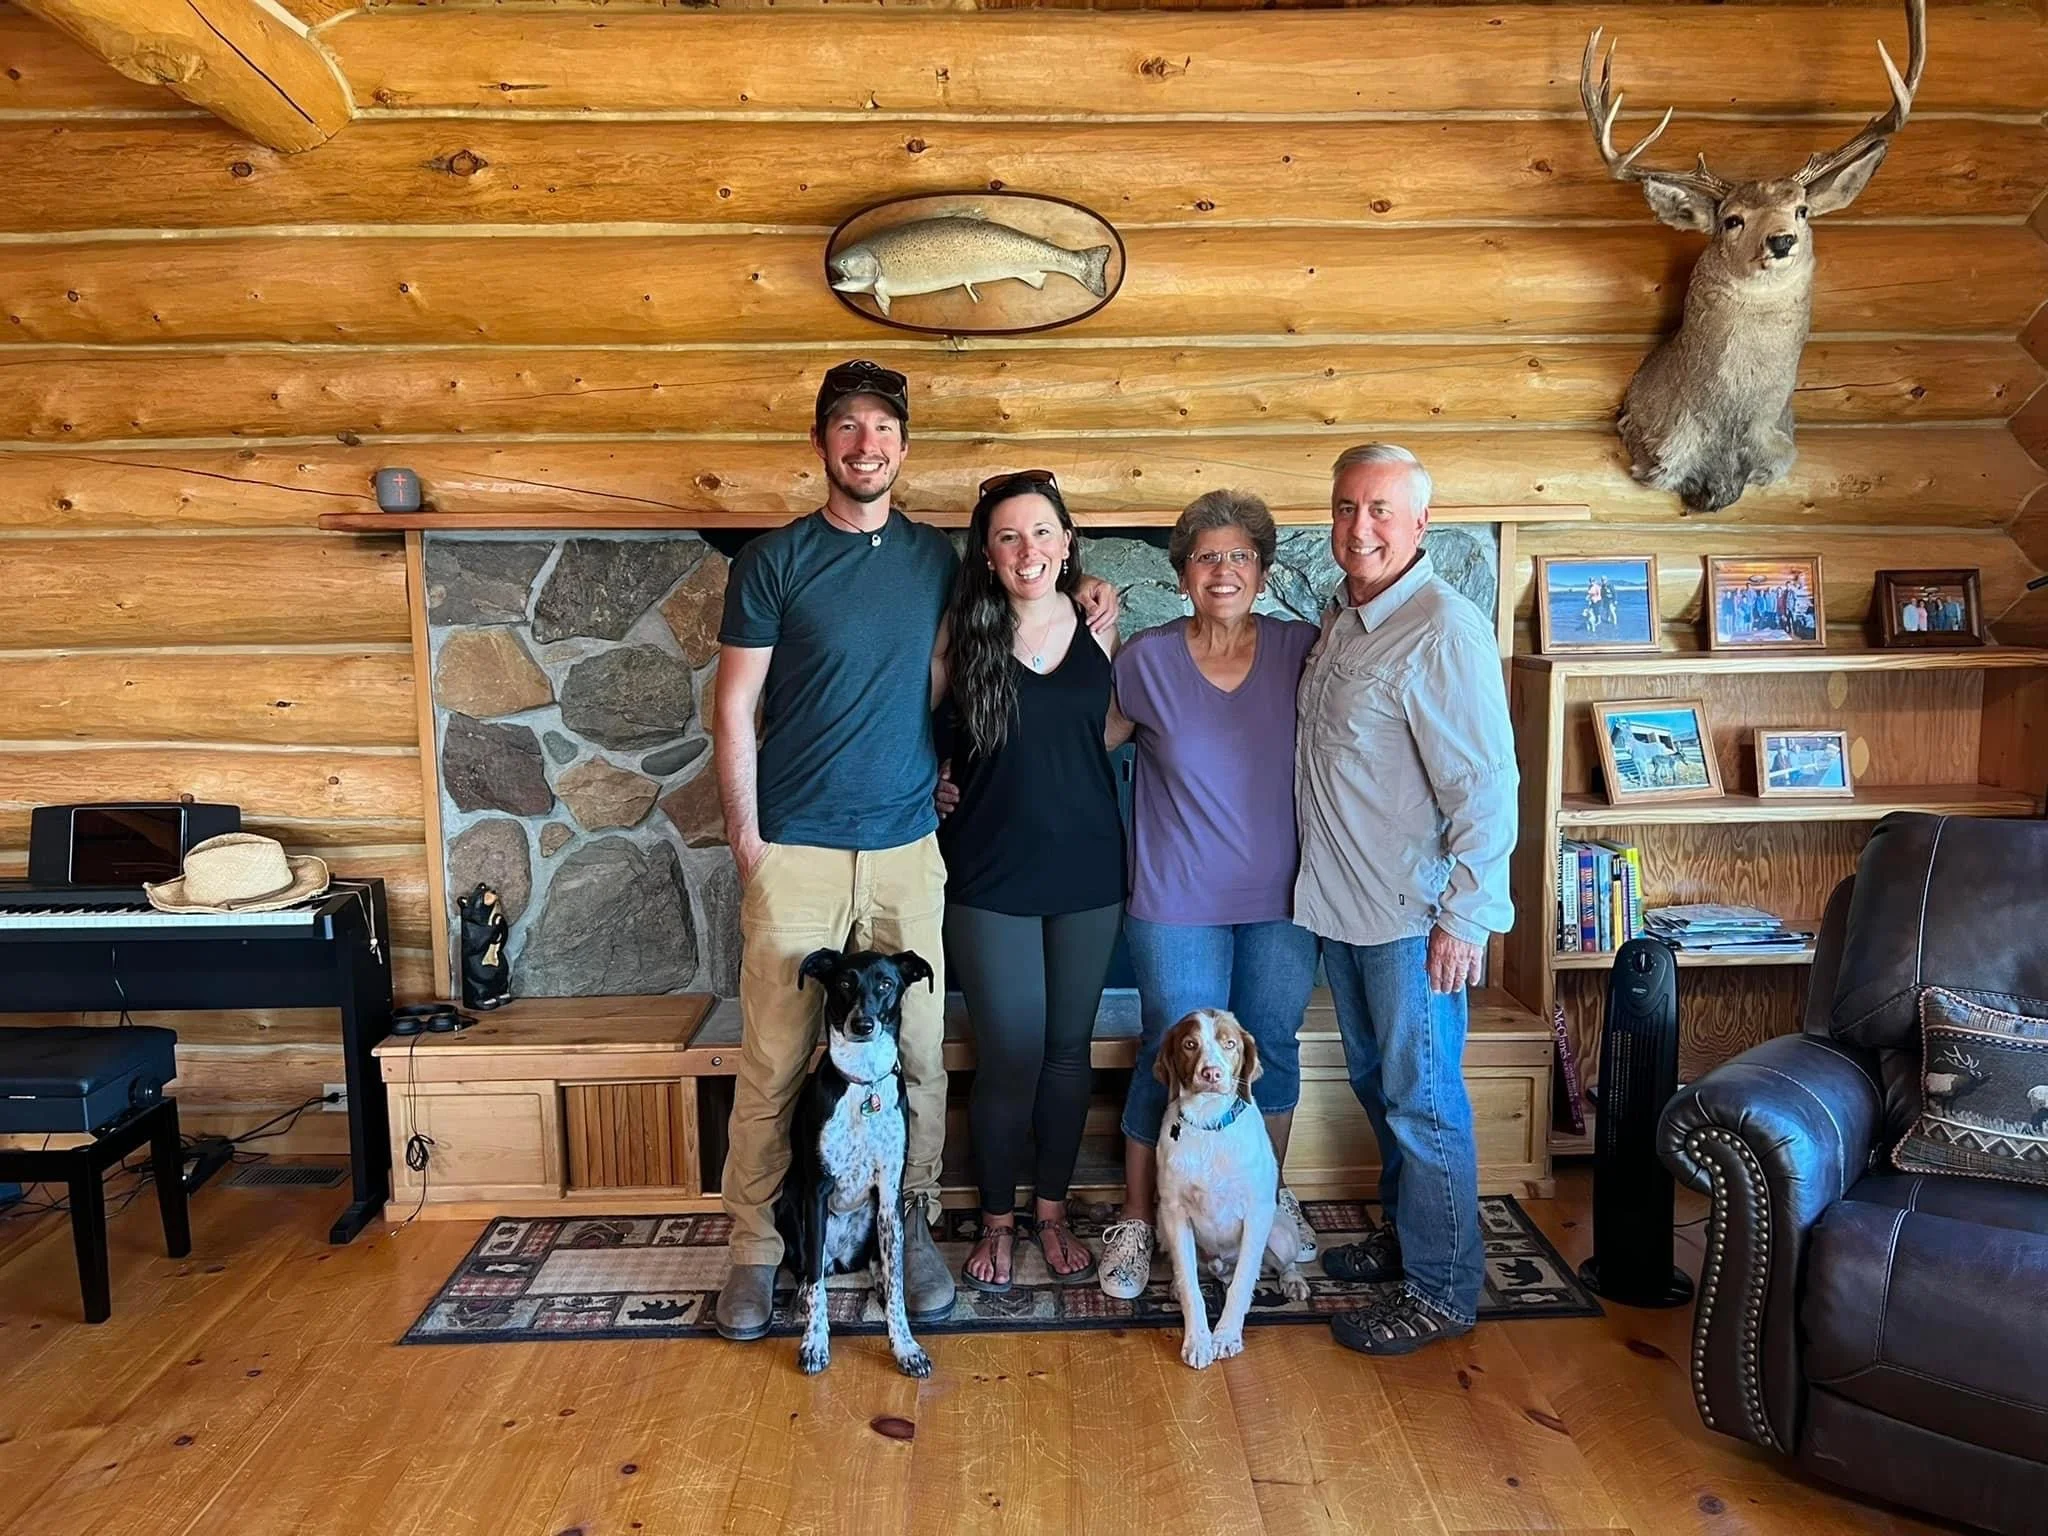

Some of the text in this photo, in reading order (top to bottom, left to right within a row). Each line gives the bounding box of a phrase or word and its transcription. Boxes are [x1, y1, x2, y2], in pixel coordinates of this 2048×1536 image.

[1584, 868, 1594, 921] TOM BROKAW
[1554, 1007, 1571, 1060] McClane's
